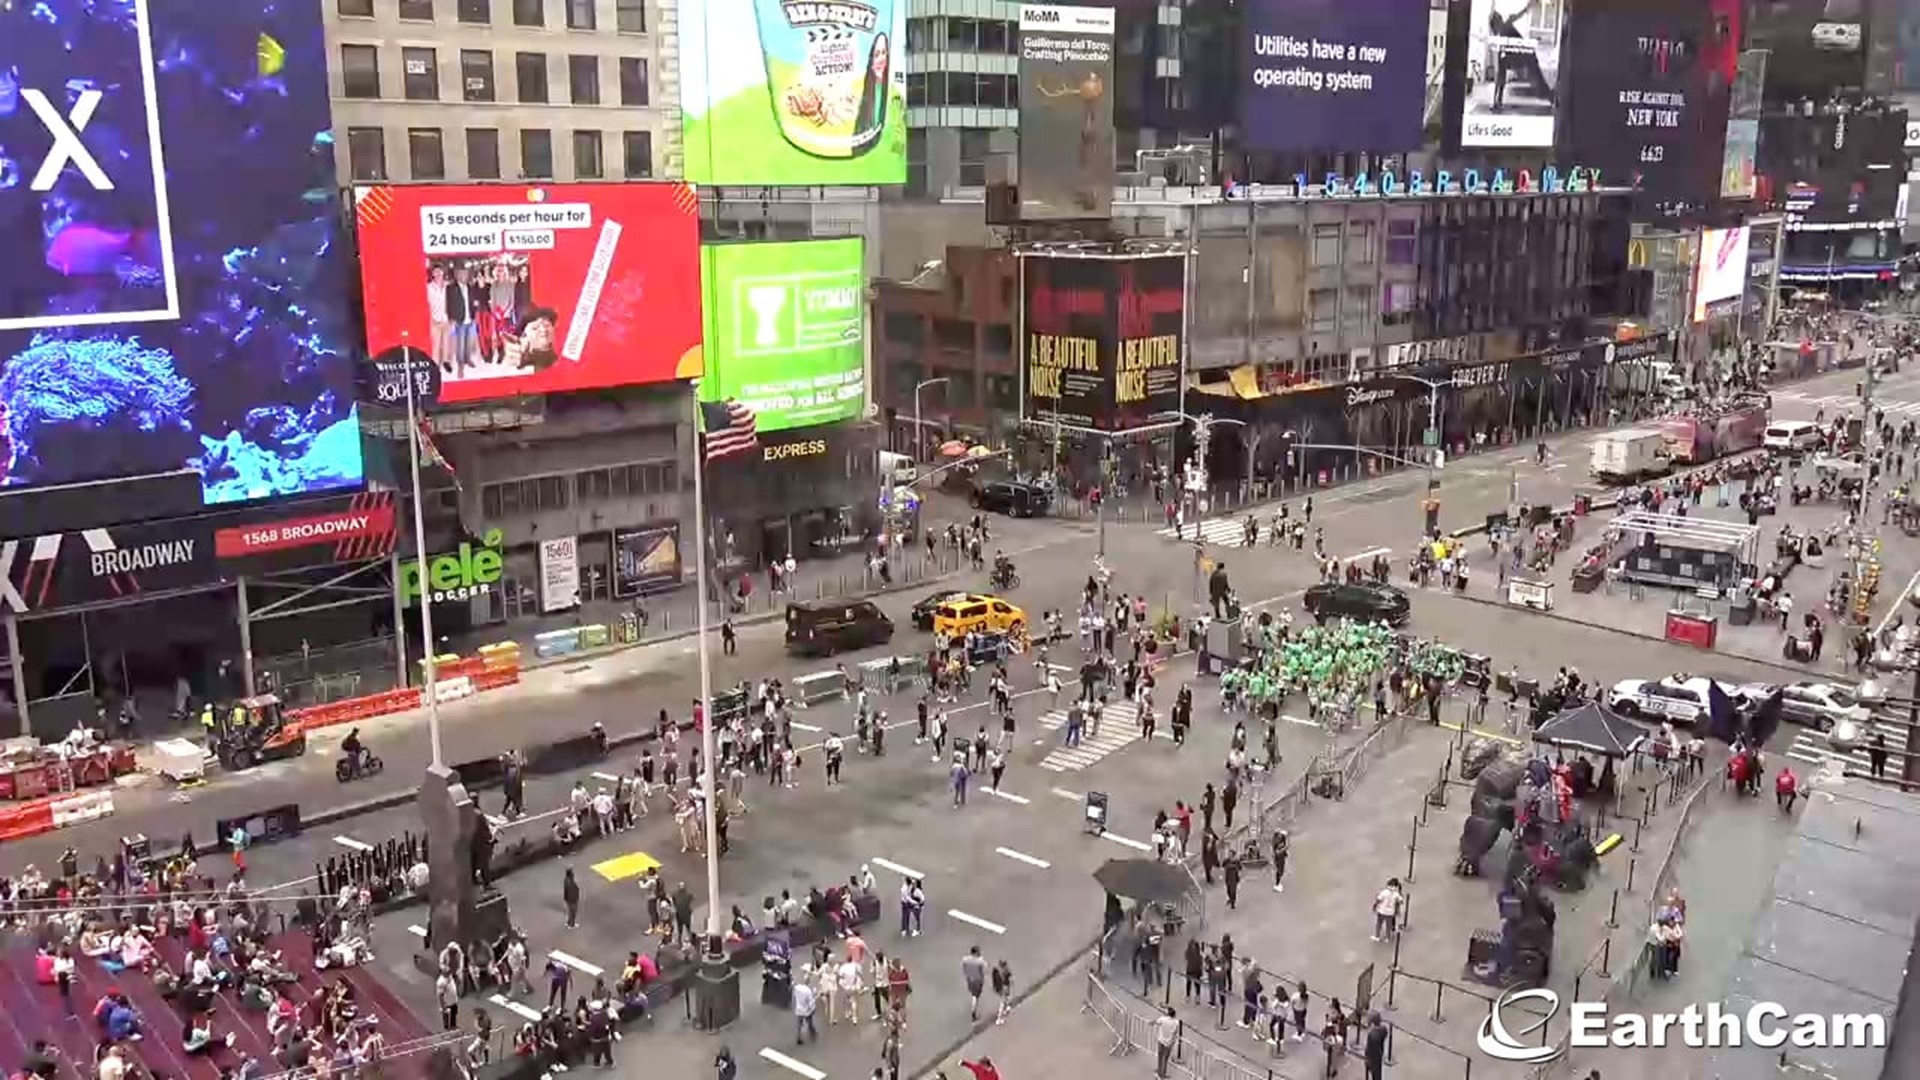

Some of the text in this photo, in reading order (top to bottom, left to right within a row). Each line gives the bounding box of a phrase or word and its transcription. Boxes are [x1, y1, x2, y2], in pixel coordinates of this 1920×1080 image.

[1024, 10, 1060, 22] MoMA
[1024, 37, 1070, 49] Guillermo
[1071, 39, 1085, 49] del
[1024, 48, 1109, 62] Crafting Pinocchio
[1254, 34, 1386, 63] Utilities have a new
[1253, 66, 1373, 91] operating system
[1619, 90, 1641, 104] RISE
[1626, 108, 1680, 127] NEW YORK
[1491, 124, 1513, 137] Good
[1408, 167, 1600, 194] BROADWAY
[427, 210, 585, 225] 15 seconds per hour for
[429, 232, 496, 246] 24 hours!
[1031, 333, 1099, 371] A BEAUTIFUL
[1115, 335, 1179, 371] A BEAUTIFUL
[1030, 367, 1062, 399] NOISE
[1115, 370, 1146, 403] NOISE
[1451, 364, 1495, 388] FOREVER
[763, 439, 826, 461] EXPRESS
[242, 516, 370, 546] 1568 BROADWAY
[91, 539, 195, 577] BROADWAY
